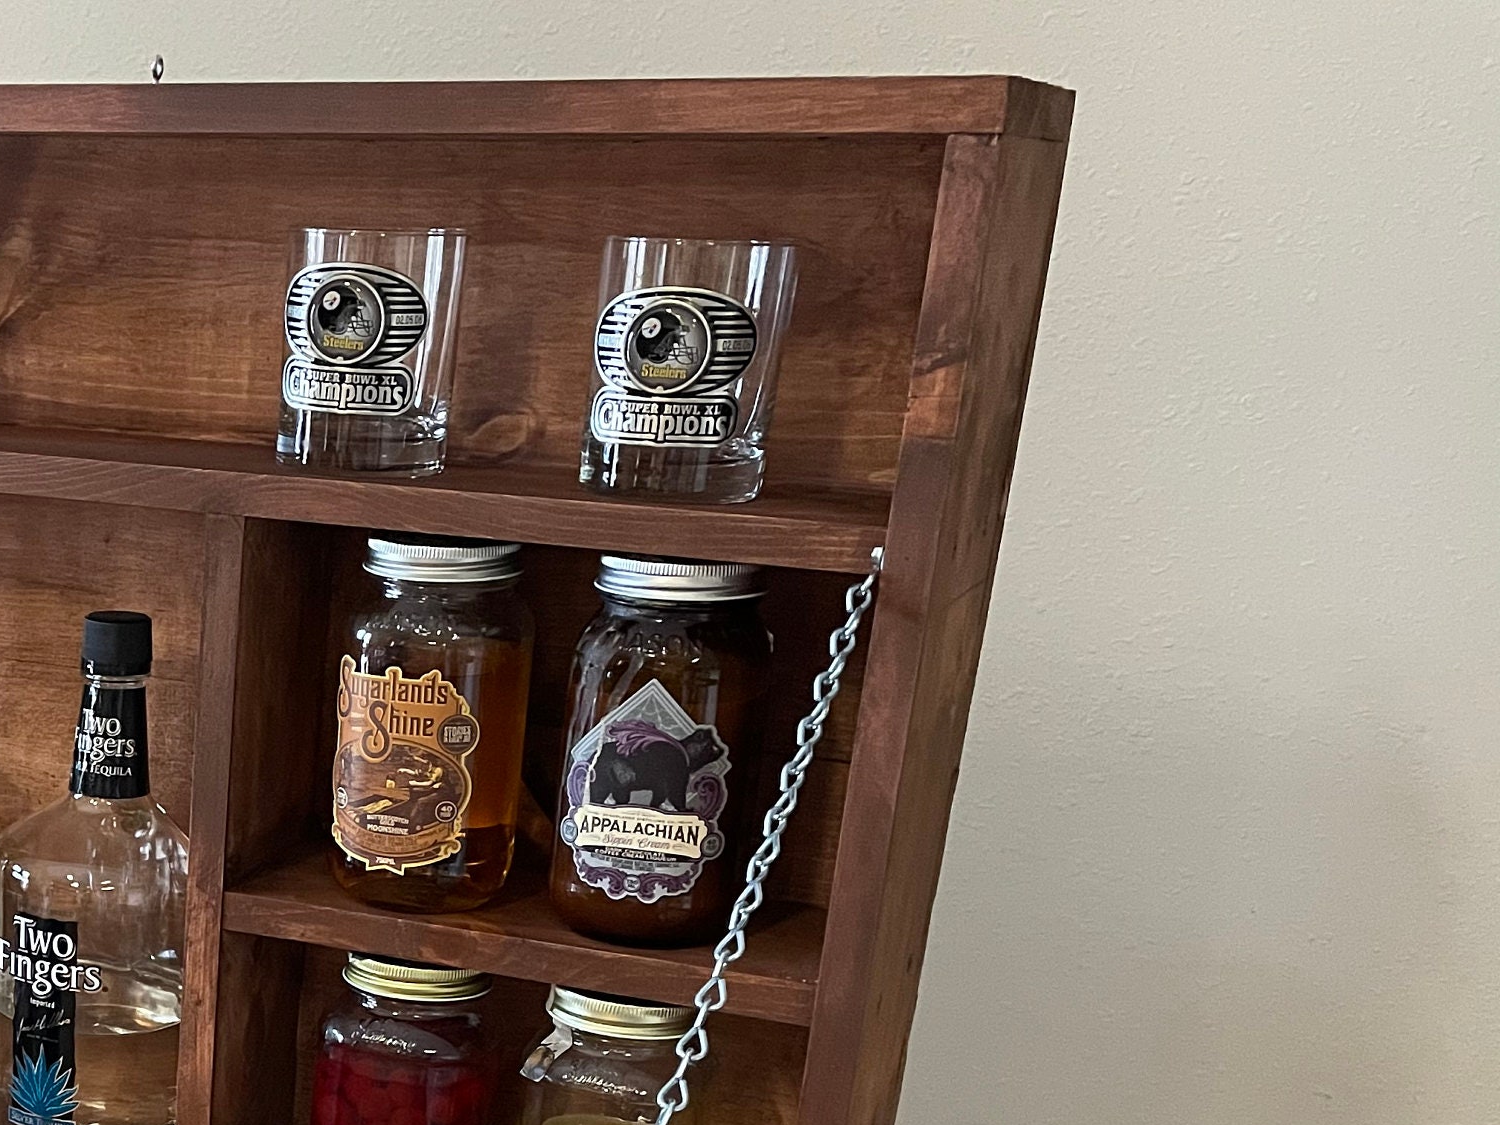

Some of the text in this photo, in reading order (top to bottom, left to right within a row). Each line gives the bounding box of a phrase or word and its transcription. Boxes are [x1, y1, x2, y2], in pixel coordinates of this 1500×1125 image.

[323, 334, 364, 350] Steelers
[307, 369, 398, 386] SUPER BOWL XL
[641, 363, 687, 379] Steelers
[289, 369, 404, 408] Champions
[600, 401, 727, 441] Champions
[620, 401, 722, 415] SUPER BOWL XL
[339, 659, 449, 717] Sugarlands
[362, 700, 435, 758] Shine
[366, 823, 409, 835] MOONSHINE
[579, 814, 700, 846] APPALACHIAN
[636, 836, 671, 850] Cream
[13, 914, 77, 962] Two
[0, 937, 103, 999] Fingers
